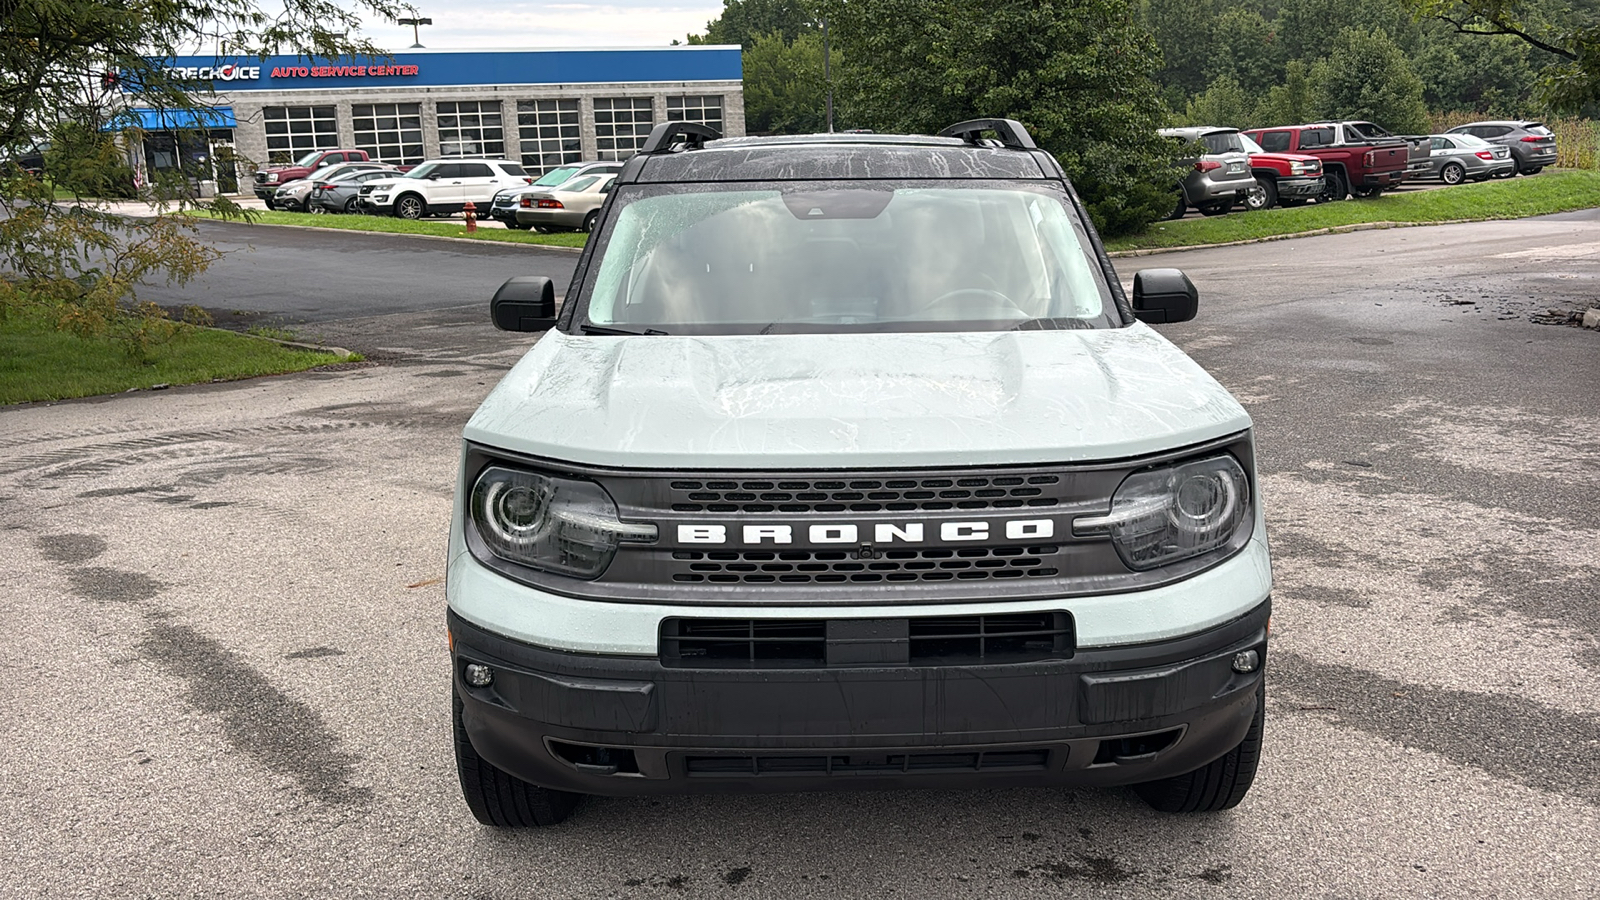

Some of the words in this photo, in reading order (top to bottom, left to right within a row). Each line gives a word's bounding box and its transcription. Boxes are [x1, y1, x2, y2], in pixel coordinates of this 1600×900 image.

[271, 67, 309, 78] AUTO
[310, 66, 366, 77] SERVICE
[367, 65, 419, 76] CENTER
[677, 519, 1054, 544] BRONCO
